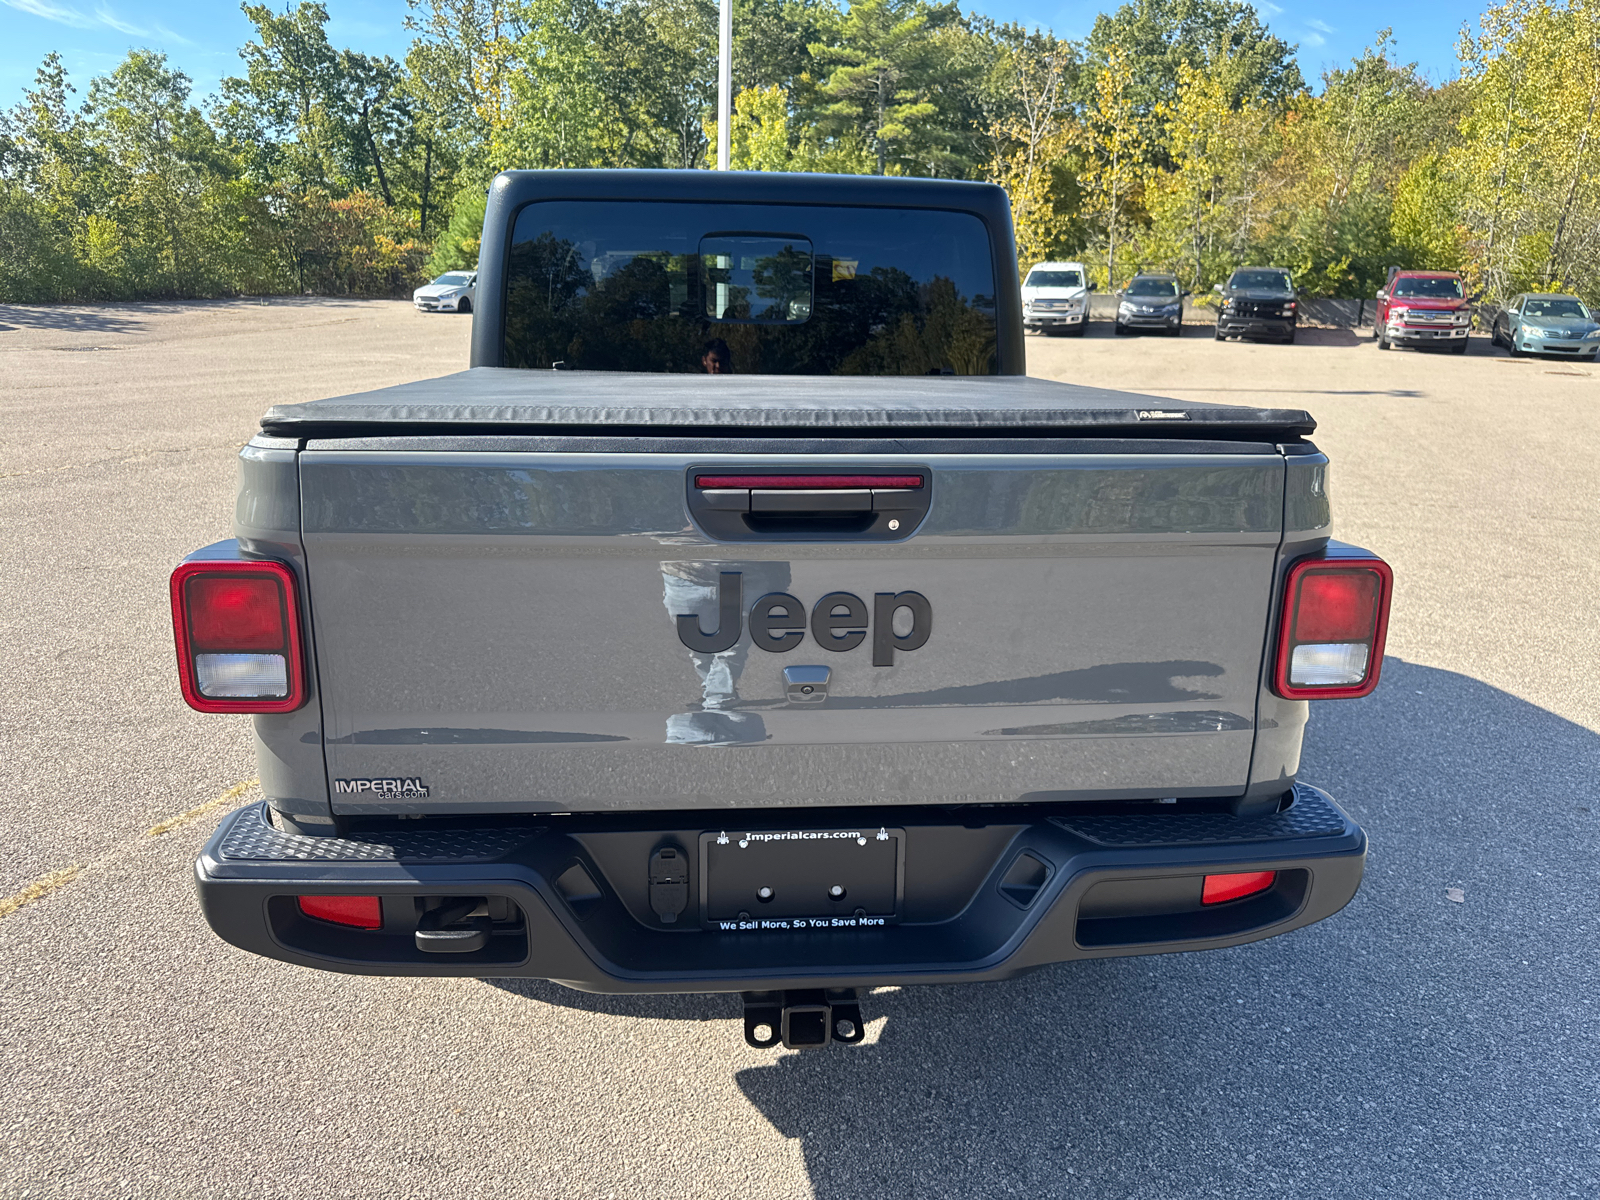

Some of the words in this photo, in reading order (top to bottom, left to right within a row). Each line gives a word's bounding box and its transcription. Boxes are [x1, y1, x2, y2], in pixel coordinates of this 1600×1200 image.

[676, 571, 933, 667] Jeep
[335, 779, 427, 793] IMPERIAL
[378, 790, 428, 799] cars.com
[745, 831, 861, 842] Imperialcars.com
[720, 922, 737, 931] We
[739, 921, 759, 930] Sell
[761, 920, 791, 930] More,
[793, 919, 807, 929] So
[809, 919, 829, 928] You
[831, 918, 857, 927] Save
[859, 917, 885, 926] More
